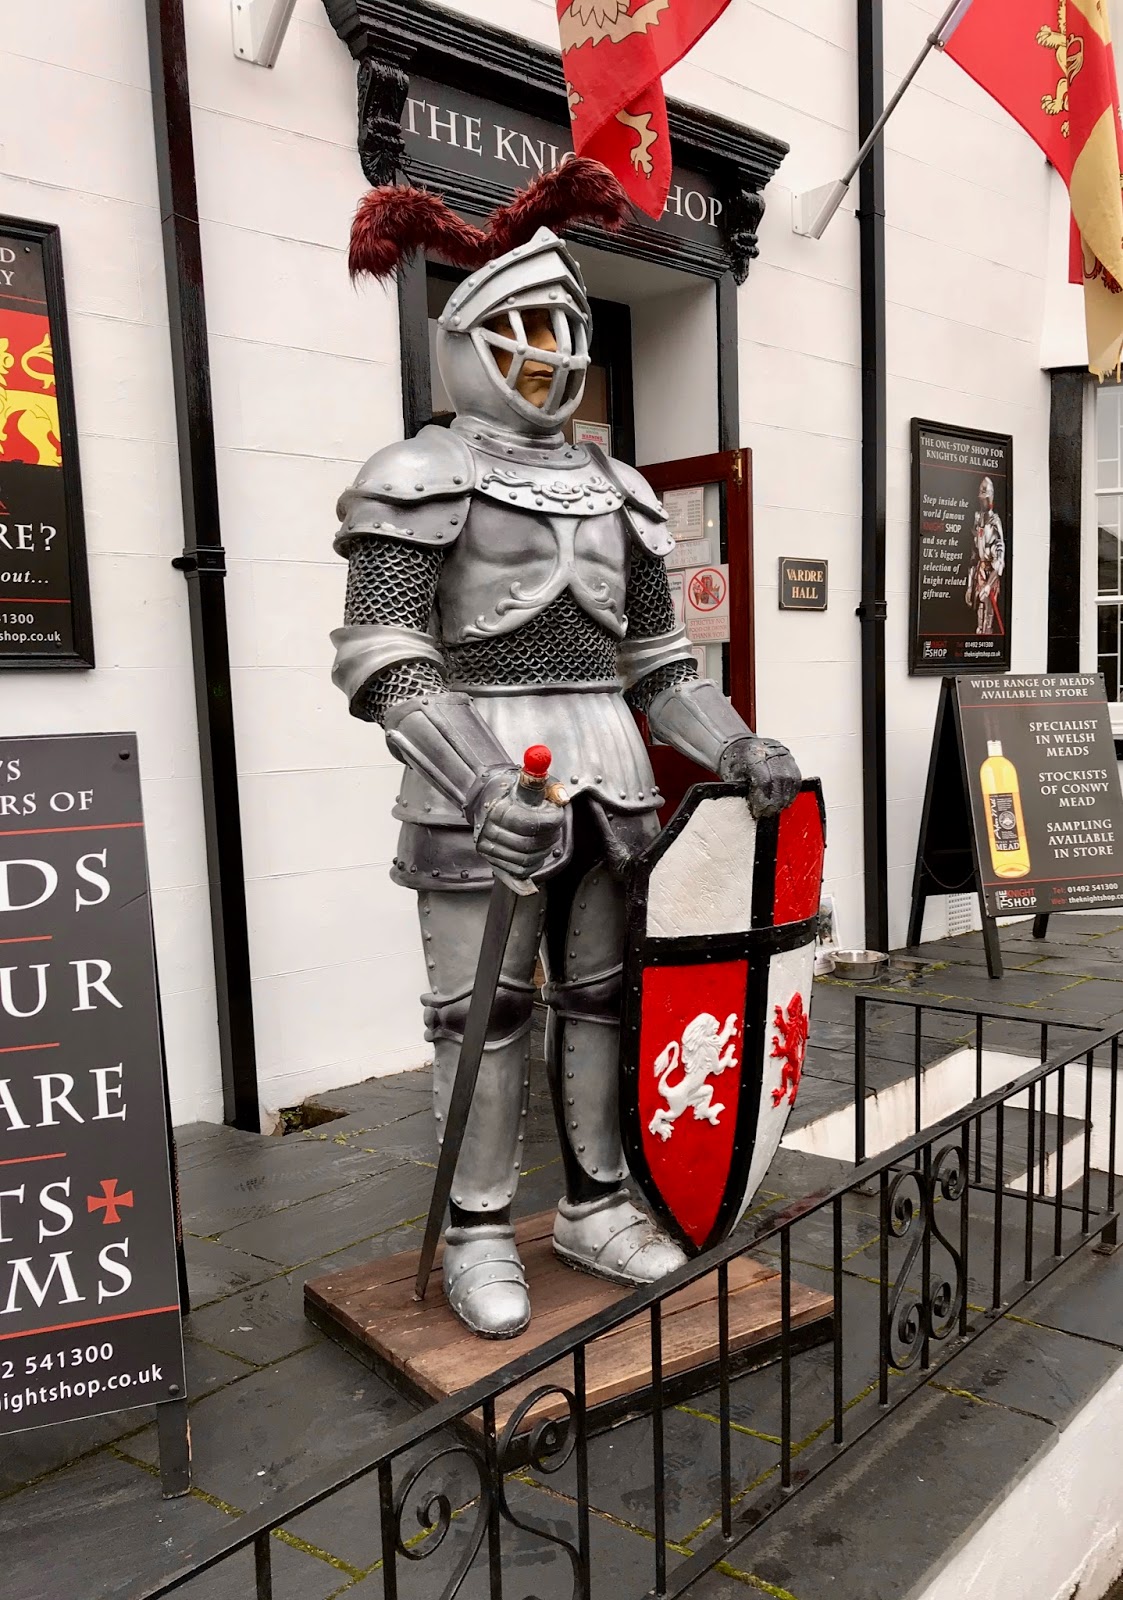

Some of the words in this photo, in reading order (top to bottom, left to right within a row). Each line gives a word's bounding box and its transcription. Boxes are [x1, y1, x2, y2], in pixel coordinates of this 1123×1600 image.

[404, 97, 483, 157] THE
[664, 185, 722, 228] HOP
[920, 436, 934, 447] THE
[936, 440, 970, 453] ONE-STOP
[971, 446, 989, 456] SHOP
[990, 448, 1004, 458] FOR
[926, 450, 957, 462] KNIGHTS
[959, 454, 968, 464] OF
[969, 456, 981, 465] ALL
[982, 459, 998, 468] AGES
[923, 494, 937, 506] Step
[939, 496, 957, 506] inside
[959, 499, 969, 508] the
[923, 509, 941, 518] world
[942, 510, 965, 521] famous
[945, 524, 961, 533] SHOP
[923, 536, 935, 544] and
[949, 537, 958, 546] the
[923, 548, 938, 558] UK's
[940, 550, 963, 561] biggest
[923, 562, 951, 572] selection
[953, 564, 961, 574] of
[786, 569, 824, 582] VARDRE
[923, 575, 943, 587] knight
[945, 576, 967, 585] related
[792, 586, 818, 599] HALL
[923, 589, 951, 600] giftware.
[0, 613, 34, 624] 1300
[930, 648, 947, 657] SHOP
[971, 679, 1000, 688] WIDE
[1003, 678, 1039, 688] RANGE
[1042, 678, 1056, 686] OF
[1059, 677, 1095, 686] MEADS
[981, 689, 1037, 699] AVAILABLE
[1040, 689, 1052, 697] IN
[1055, 688, 1088, 697] STORE
[1029, 720, 1098, 732] SPECIALIST
[1036, 735, 1050, 745] IN
[1053, 733, 1095, 744] WELSH
[1046, 746, 1089, 757] MEADS
[1038, 769, 1108, 782] STOCKISTS
[1040, 785, 1058, 795] OF
[1062, 782, 1110, 793] CONWY
[49, 789, 94, 812] OF
[1059, 796, 1096, 807] MEAD
[1047, 819, 1112, 832] SAMPLING
[1048, 832, 1115, 846] AVAILABLE
[1054, 849, 1069, 859] IN
[1073, 846, 1114, 857] STORE
[1007, 888, 1035, 897] KNIGHT
[1092, 883, 1118, 891] 541300
[1008, 896, 1037, 908] SHOP
[2, 1361, 15, 1379] 2
[25, 1342, 114, 1374] 541300
[0, 1364, 163, 1413] ightshop.co.uk
